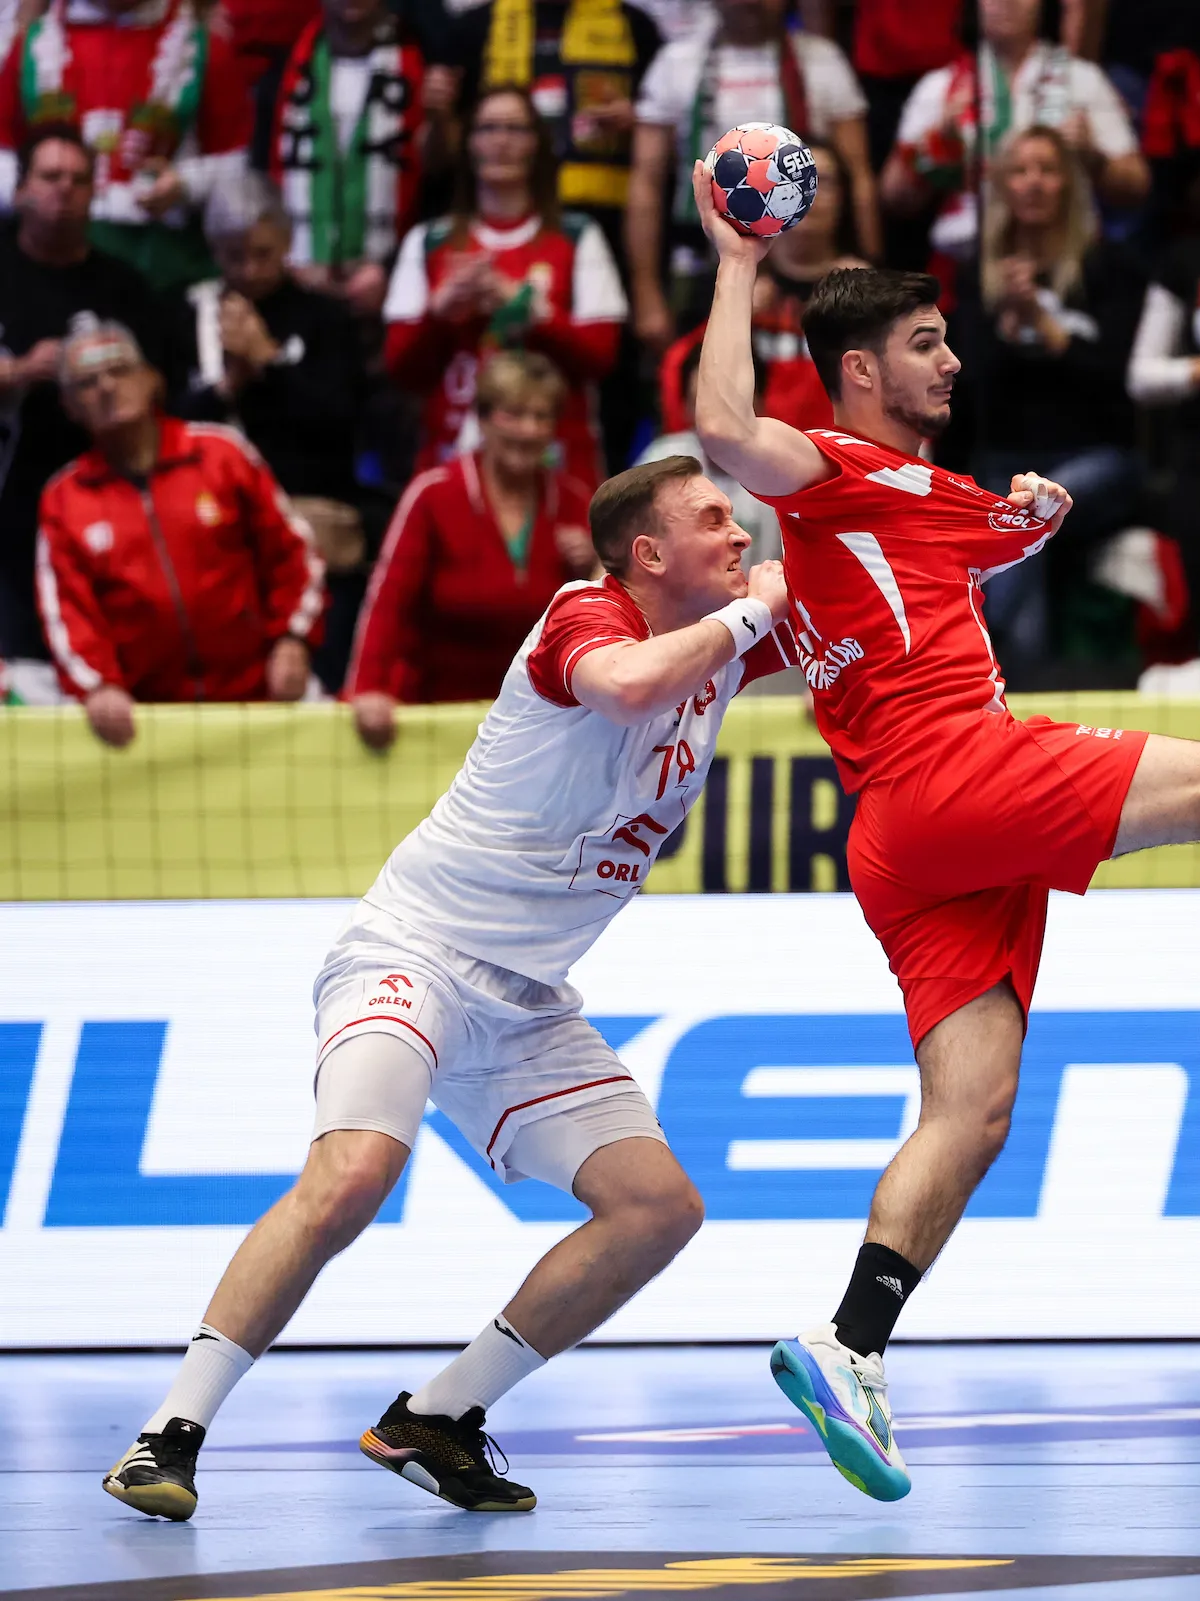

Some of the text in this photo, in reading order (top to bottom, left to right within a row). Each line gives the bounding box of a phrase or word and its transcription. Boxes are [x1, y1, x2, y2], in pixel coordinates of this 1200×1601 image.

[998, 513, 1031, 528] MOL
[368, 996, 412, 1009] ORLEN
[875, 1275, 904, 1300] adidas
